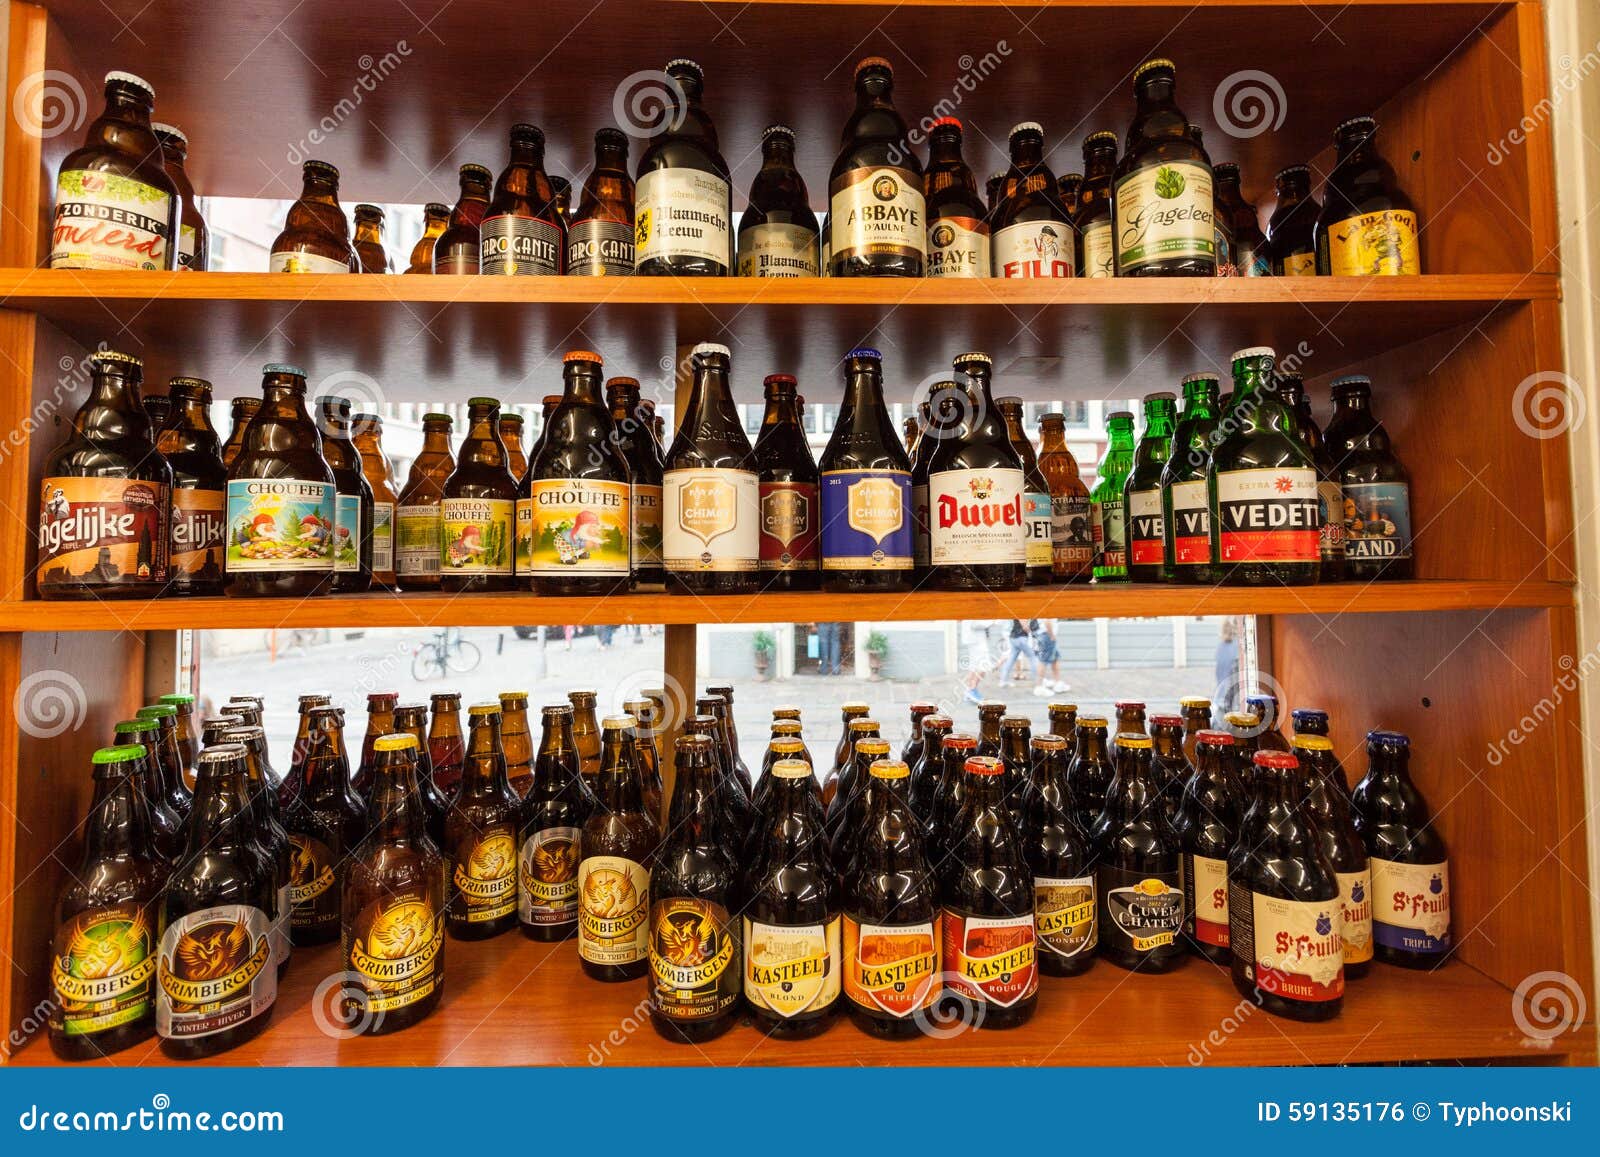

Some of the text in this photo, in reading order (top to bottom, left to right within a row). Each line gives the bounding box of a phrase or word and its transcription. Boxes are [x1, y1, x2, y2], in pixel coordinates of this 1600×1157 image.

[64, 203, 159, 232] ZONDERIK
[848, 206, 919, 227] ABBAYE
[1122, 201, 1213, 249] Gageleer
[248, 483, 324, 497] CHOUFFE
[539, 491, 620, 507] CHOUFFE
[443, 511, 491, 521] CHOUFFE
[444, 503, 490, 511] HOUBLON
[937, 493, 1023, 529] Duvel
[1402, 936, 1433, 949] TRIPLE
[357, 933, 444, 977] GRIMBERGEN
[965, 946, 1034, 979] KASTEEL
[163, 957, 264, 998] GRIMBERGEN
[752, 958, 822, 985] KASTEEL
[861, 958, 933, 987] KASTEEL
[770, 992, 806, 1001] BLOND
[989, 984, 1022, 993] ROUGE
[175, 1022, 209, 1032] WINTER
